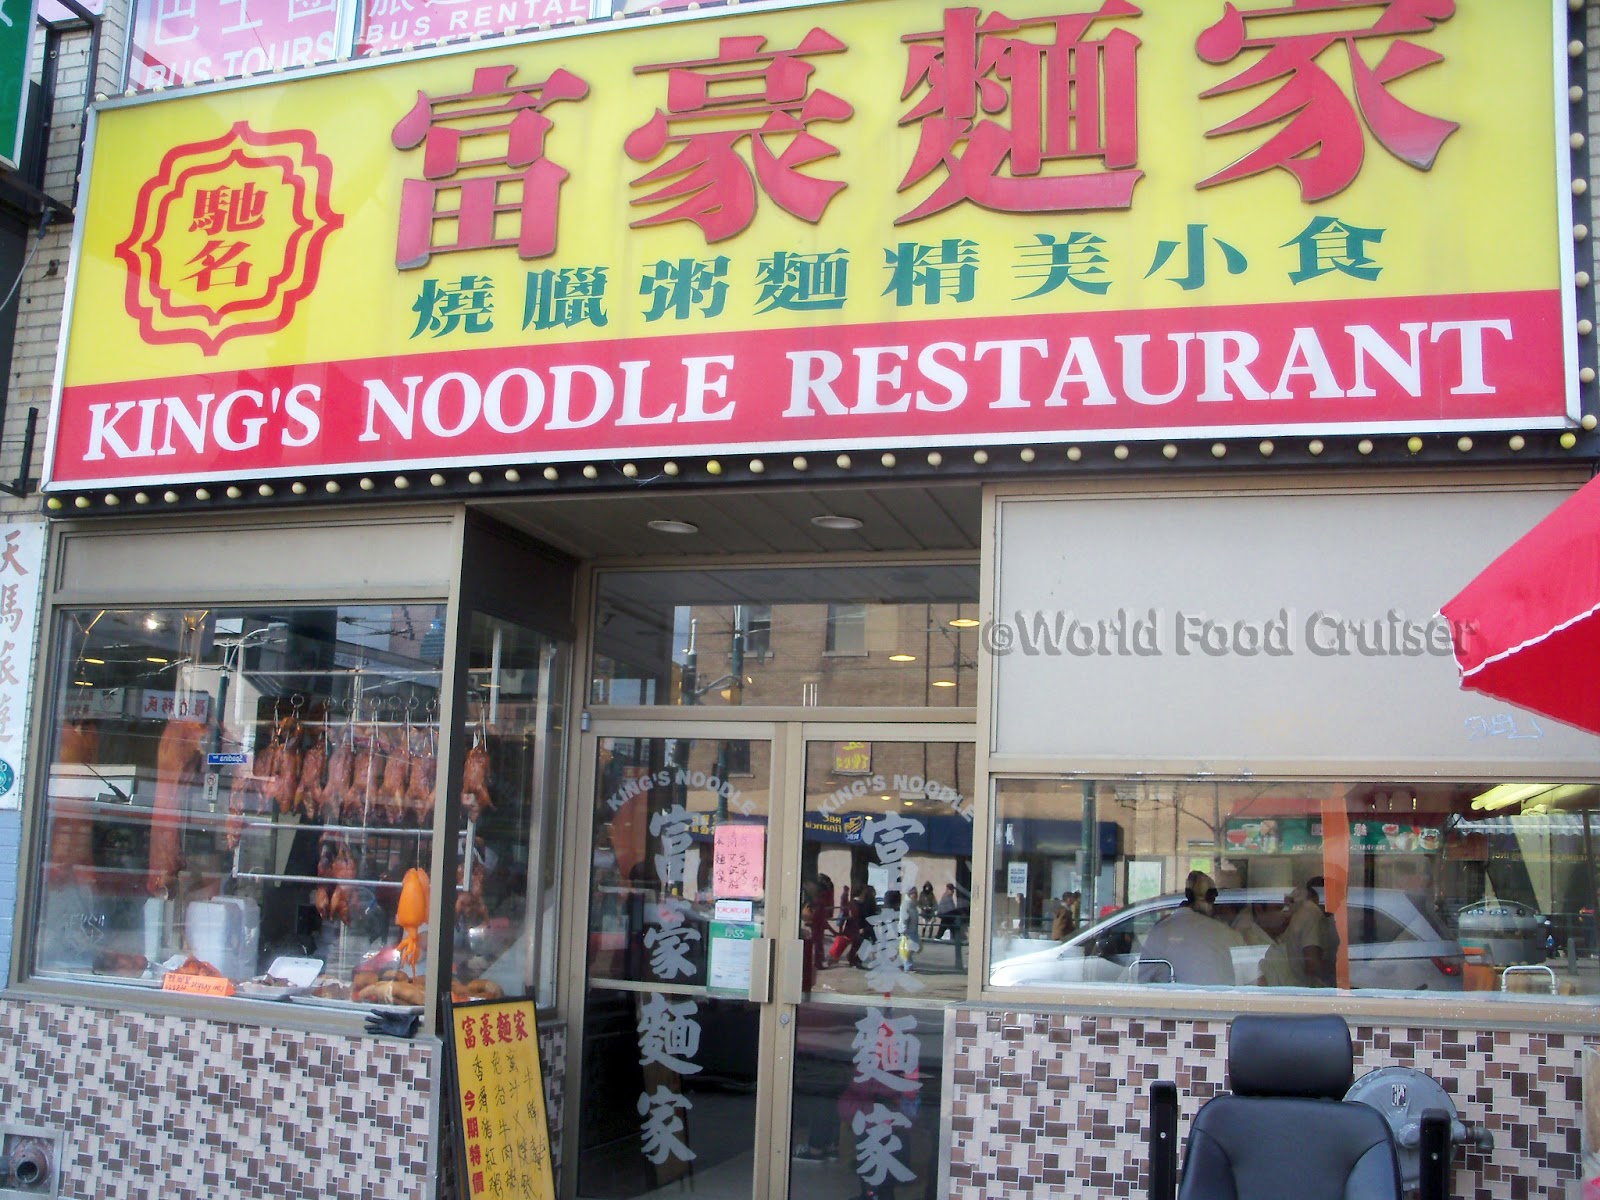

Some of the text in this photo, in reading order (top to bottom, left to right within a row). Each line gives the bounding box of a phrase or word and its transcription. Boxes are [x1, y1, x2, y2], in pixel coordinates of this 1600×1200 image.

[367, 16, 431, 44] BUS
[450, 0, 587, 30] RENTAL
[145, 57, 212, 91] BUS
[223, 31, 334, 80] TOURS
[391, 0, 1460, 271] 富豪麵家
[188, 186, 266, 293] 馳名
[83, 318, 1514, 463] KING'S NOODLE RESTAURANT
[607, 769, 758, 816] KING'S NOODLE
[818, 774, 975, 823] KING'S NOODLE
